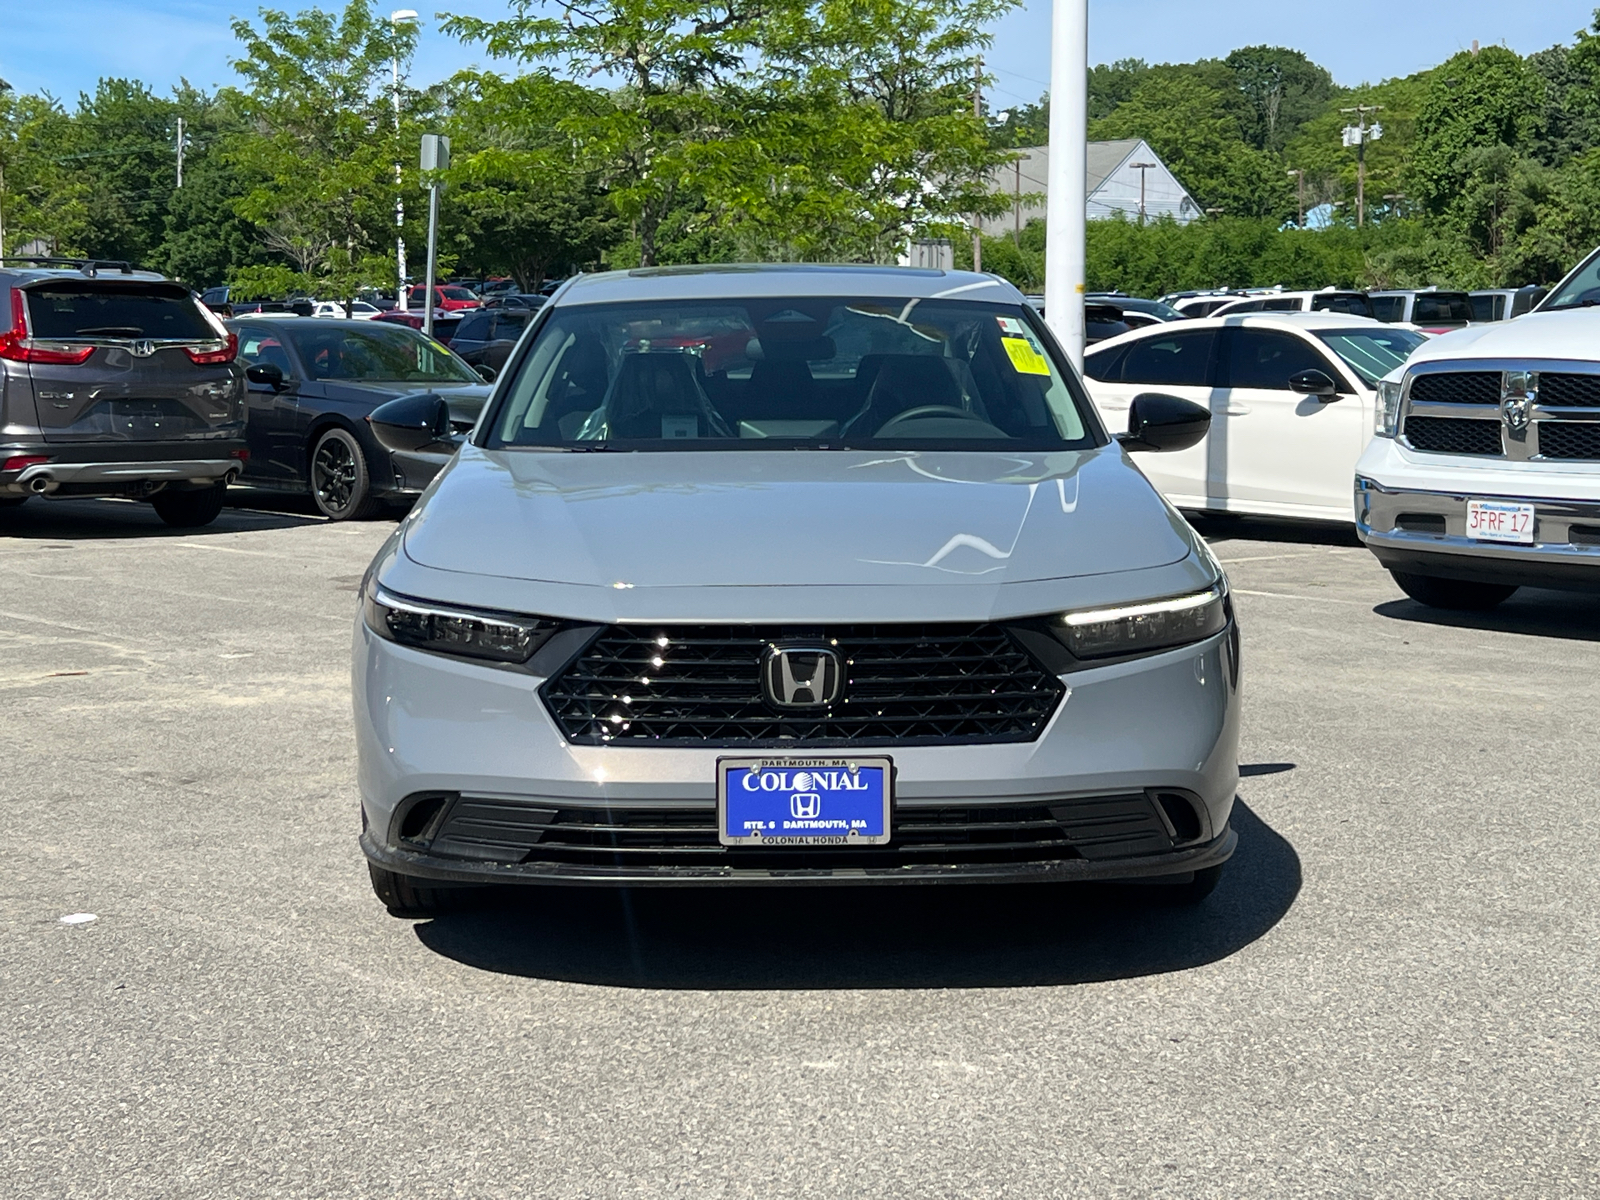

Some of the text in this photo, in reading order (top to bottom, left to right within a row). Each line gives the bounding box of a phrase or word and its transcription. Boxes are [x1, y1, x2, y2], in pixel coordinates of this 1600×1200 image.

[1470, 511, 1529, 532] 3FRF 17
[742, 771, 868, 792] COLONIAL
[744, 820, 867, 830] RTE. 6 DARTMOUTH, MA
[762, 836, 848, 844] COLONIAL HONDA
